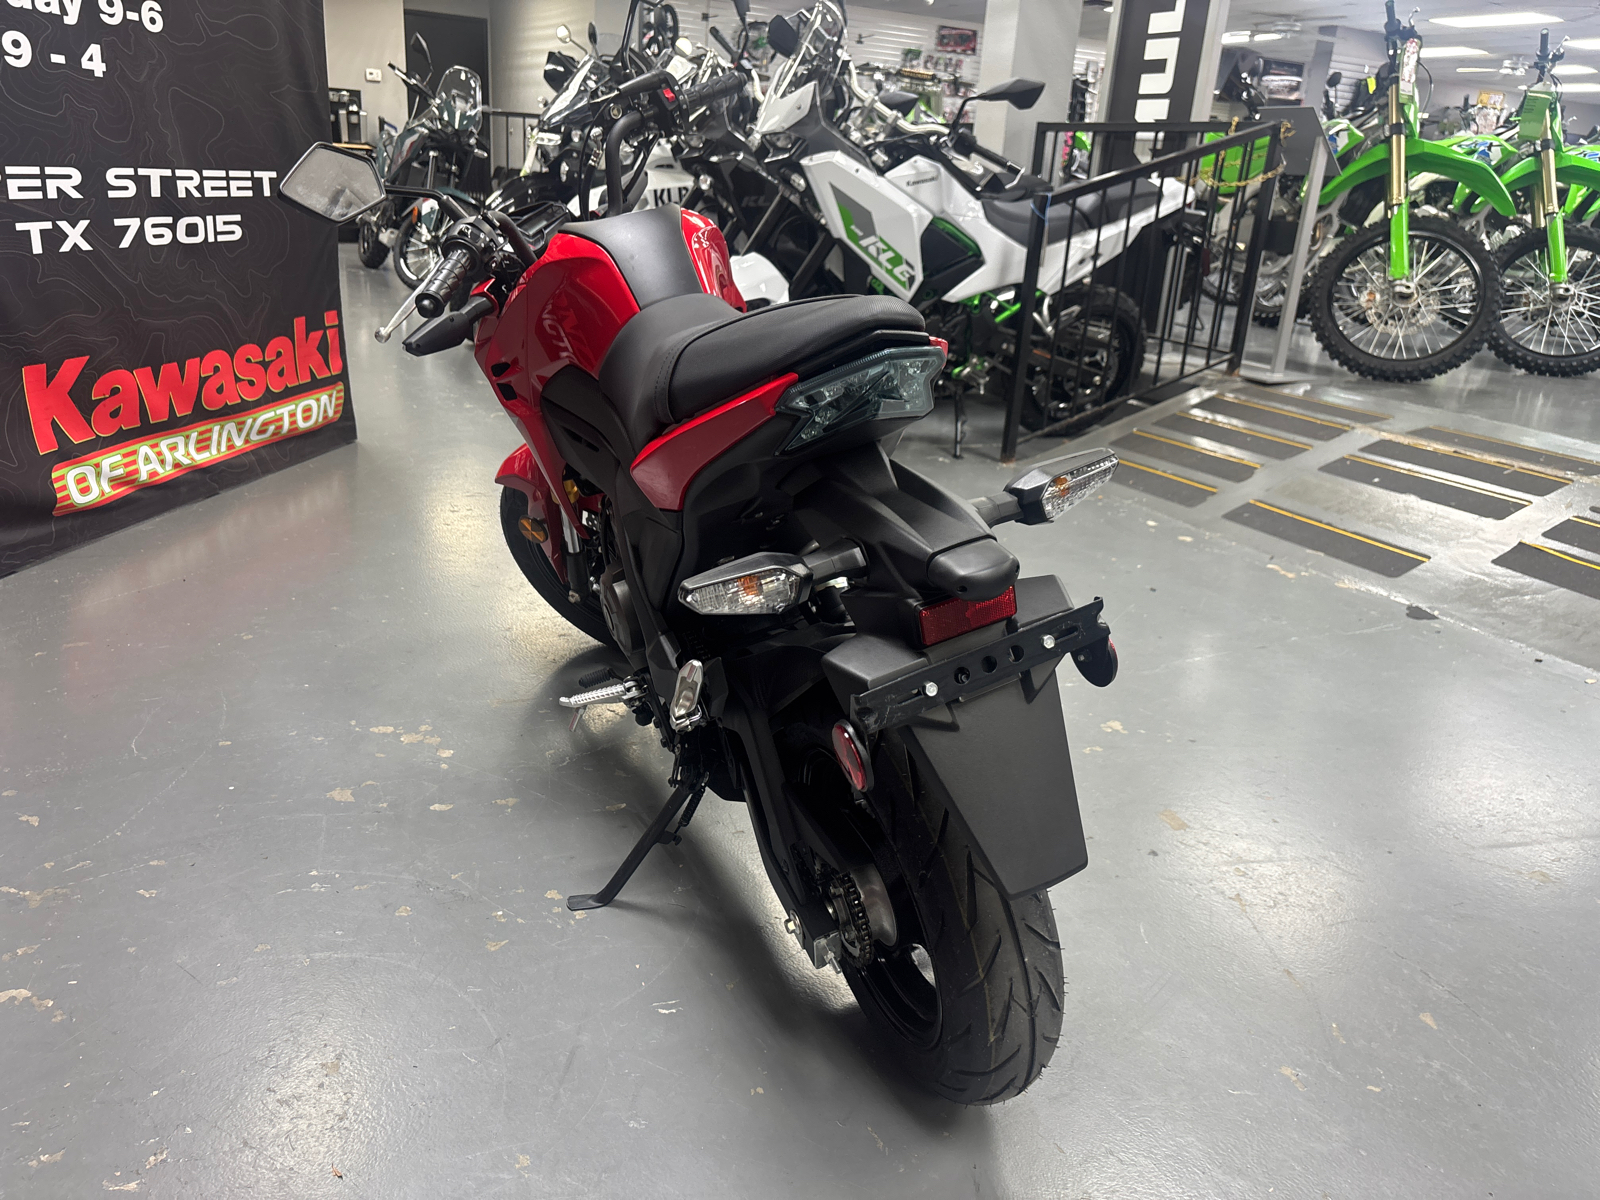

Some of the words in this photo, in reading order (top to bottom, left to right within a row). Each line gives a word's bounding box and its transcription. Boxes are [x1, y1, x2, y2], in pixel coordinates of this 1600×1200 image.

[7, 0, 82, 25] ay
[97, 0, 164, 33] 9-6
[1, 30, 33, 68] 9
[81, 43, 107, 78] 4
[0, 166, 84, 200] ER
[105, 167, 277, 199] STREET
[15, 219, 94, 254] TX
[114, 214, 243, 249] 76015
[22, 310, 343, 455] Kawasaki
[65, 454, 125, 505] OF
[137, 390, 338, 482] ARLINGTON
